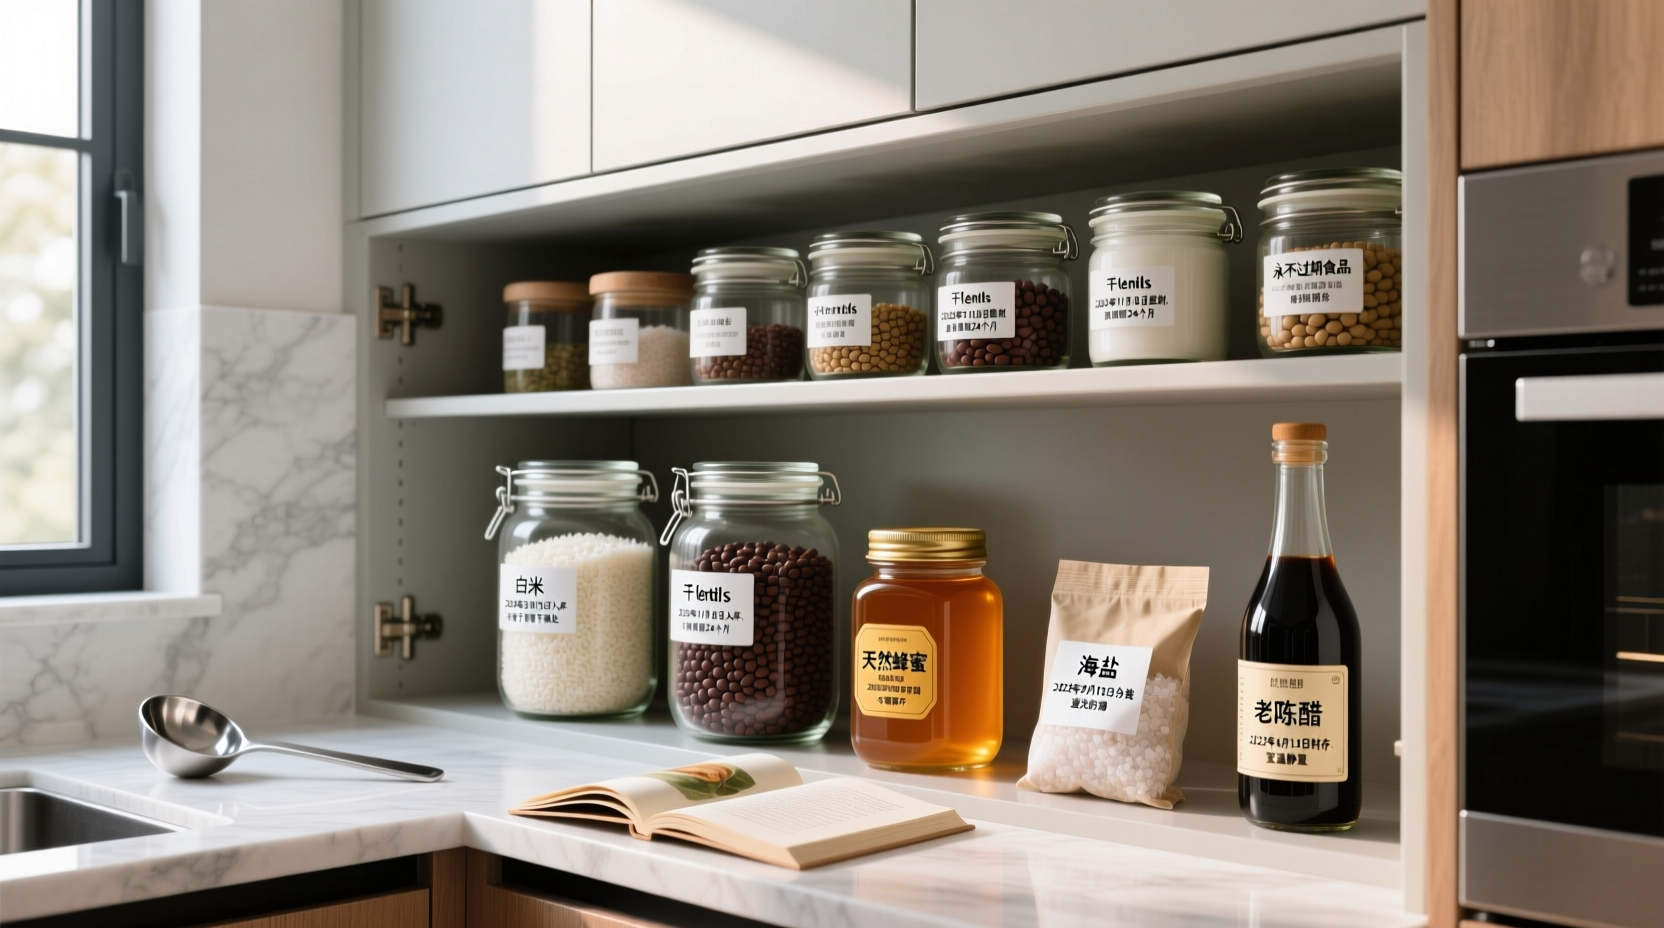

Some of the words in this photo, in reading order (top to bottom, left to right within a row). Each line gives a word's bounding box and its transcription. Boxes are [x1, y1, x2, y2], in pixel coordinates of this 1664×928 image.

[516, 574, 544, 596] 白米
[862, 651, 927, 672] 天然蜂蜜
[1078, 655, 1119, 679] 海盐
[1254, 699, 1322, 727] 老陈醋
